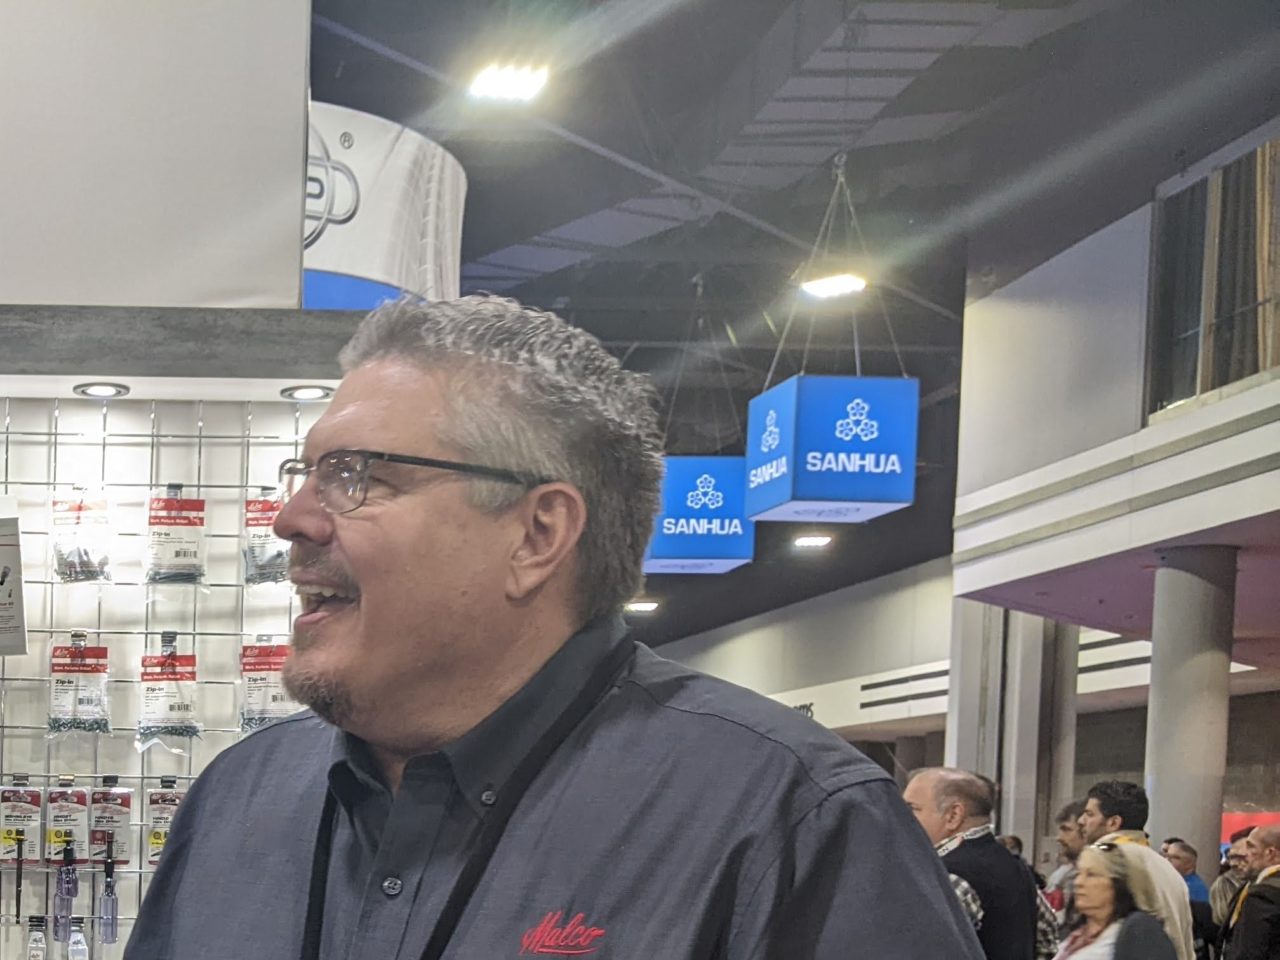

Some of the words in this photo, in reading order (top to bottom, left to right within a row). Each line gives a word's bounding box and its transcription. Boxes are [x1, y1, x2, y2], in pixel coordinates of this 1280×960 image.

[748, 455, 788, 489] SANHUA
[806, 451, 901, 474] SANHUA
[662, 518, 743, 535] SANHUA
